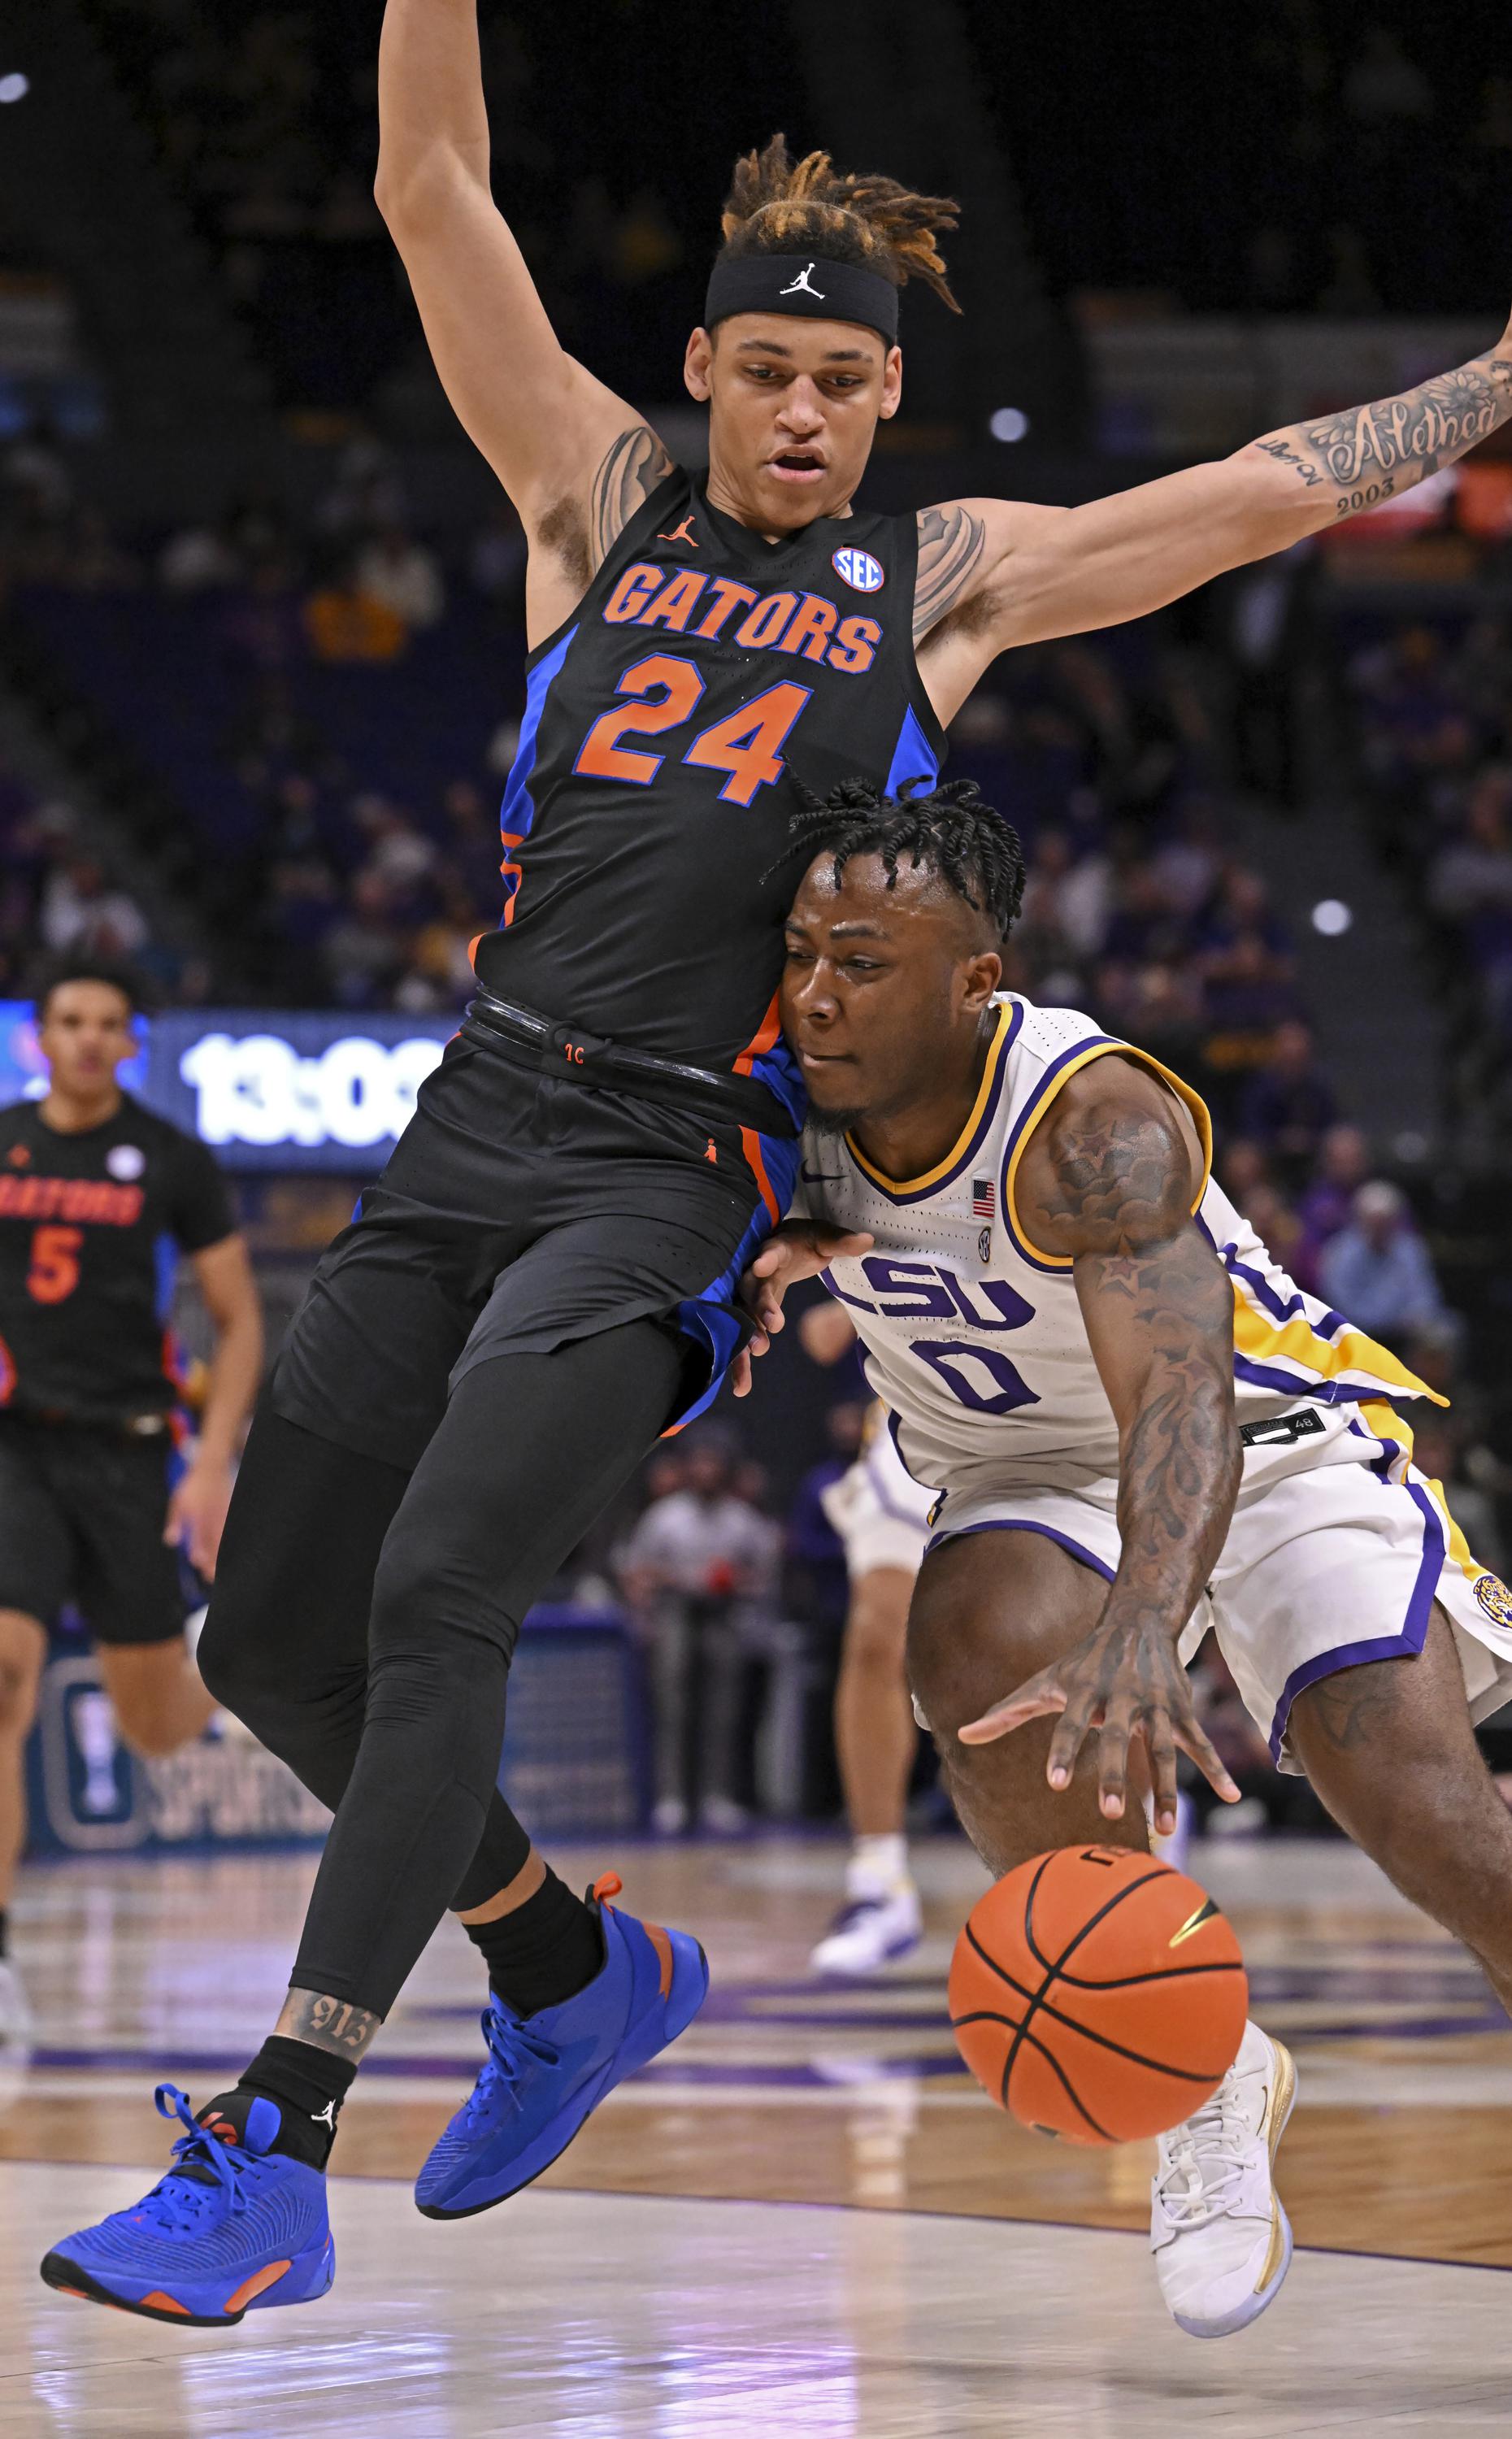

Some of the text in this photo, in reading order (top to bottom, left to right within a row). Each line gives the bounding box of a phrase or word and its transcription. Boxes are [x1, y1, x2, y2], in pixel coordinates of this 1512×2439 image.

[1336, 476, 1395, 515] 2003
[836, 549, 880, 589] SEC
[602, 561, 883, 674] GATORS
[572, 652, 814, 808] 24
[26, 1225, 84, 1305] 5
[819, 1257, 1036, 1331] LSU
[908, 1340, 1041, 1415] 0
[1295, 1418, 1314, 1428] 48
[309, 1994, 374, 2047] 913
